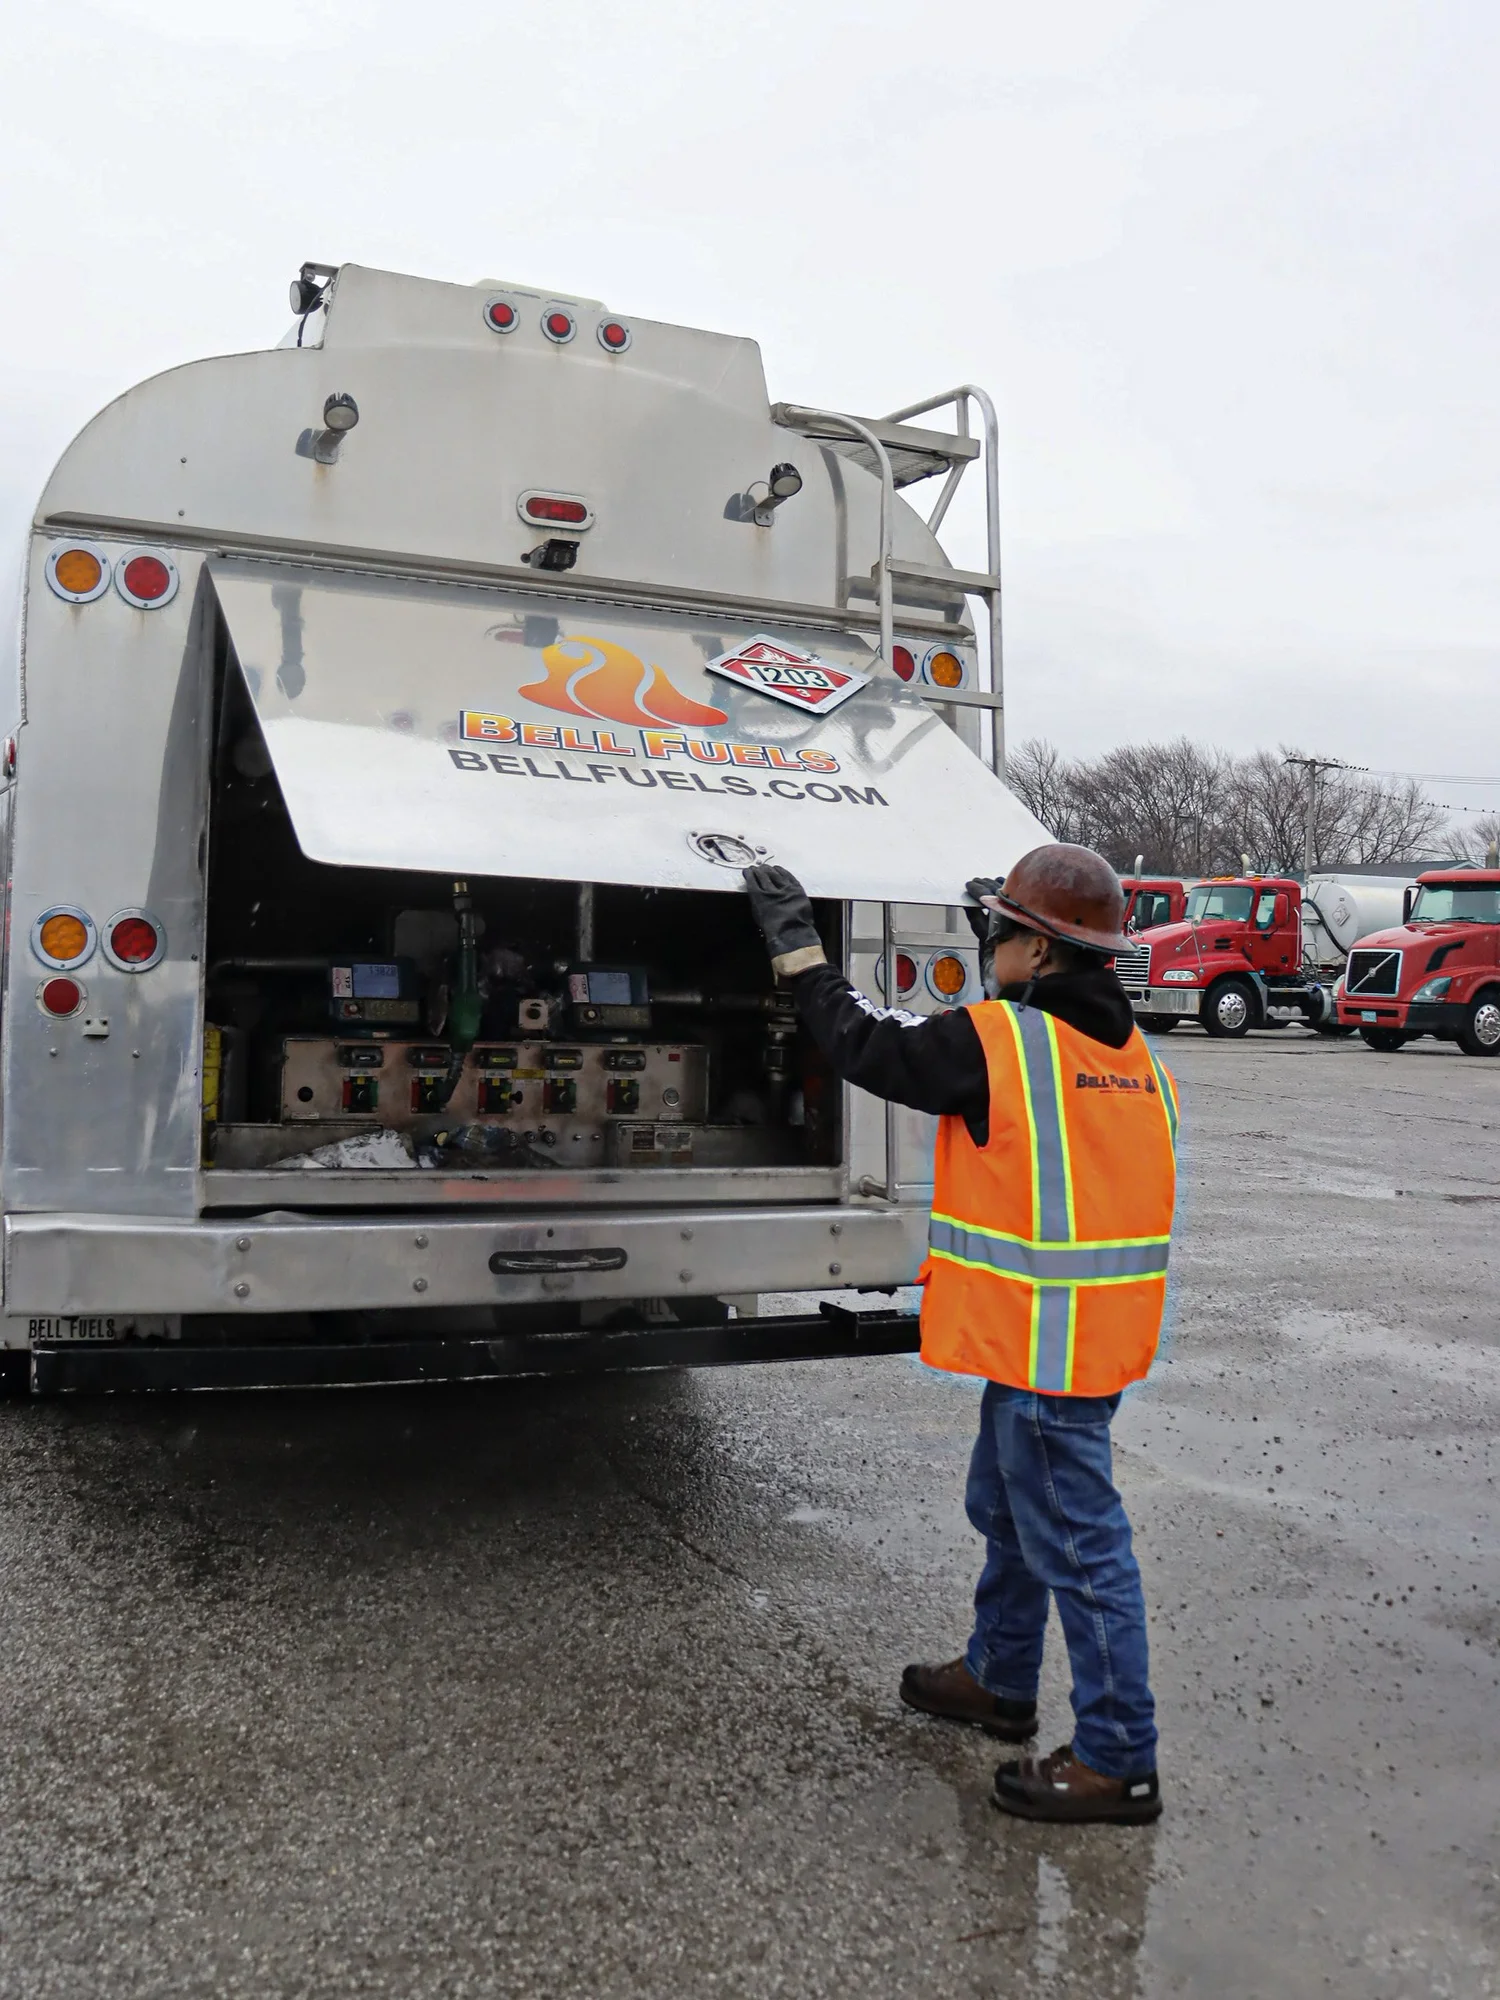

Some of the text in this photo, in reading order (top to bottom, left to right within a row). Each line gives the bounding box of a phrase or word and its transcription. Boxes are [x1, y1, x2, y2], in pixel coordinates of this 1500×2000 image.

[749, 666, 829, 688] 1203
[795, 688, 812, 698] 3
[447, 749, 890, 807] BELLFUELS.COM
[1076, 1073, 1109, 1088] BELL
[29, 1318, 115, 1338] BELL FUELS
